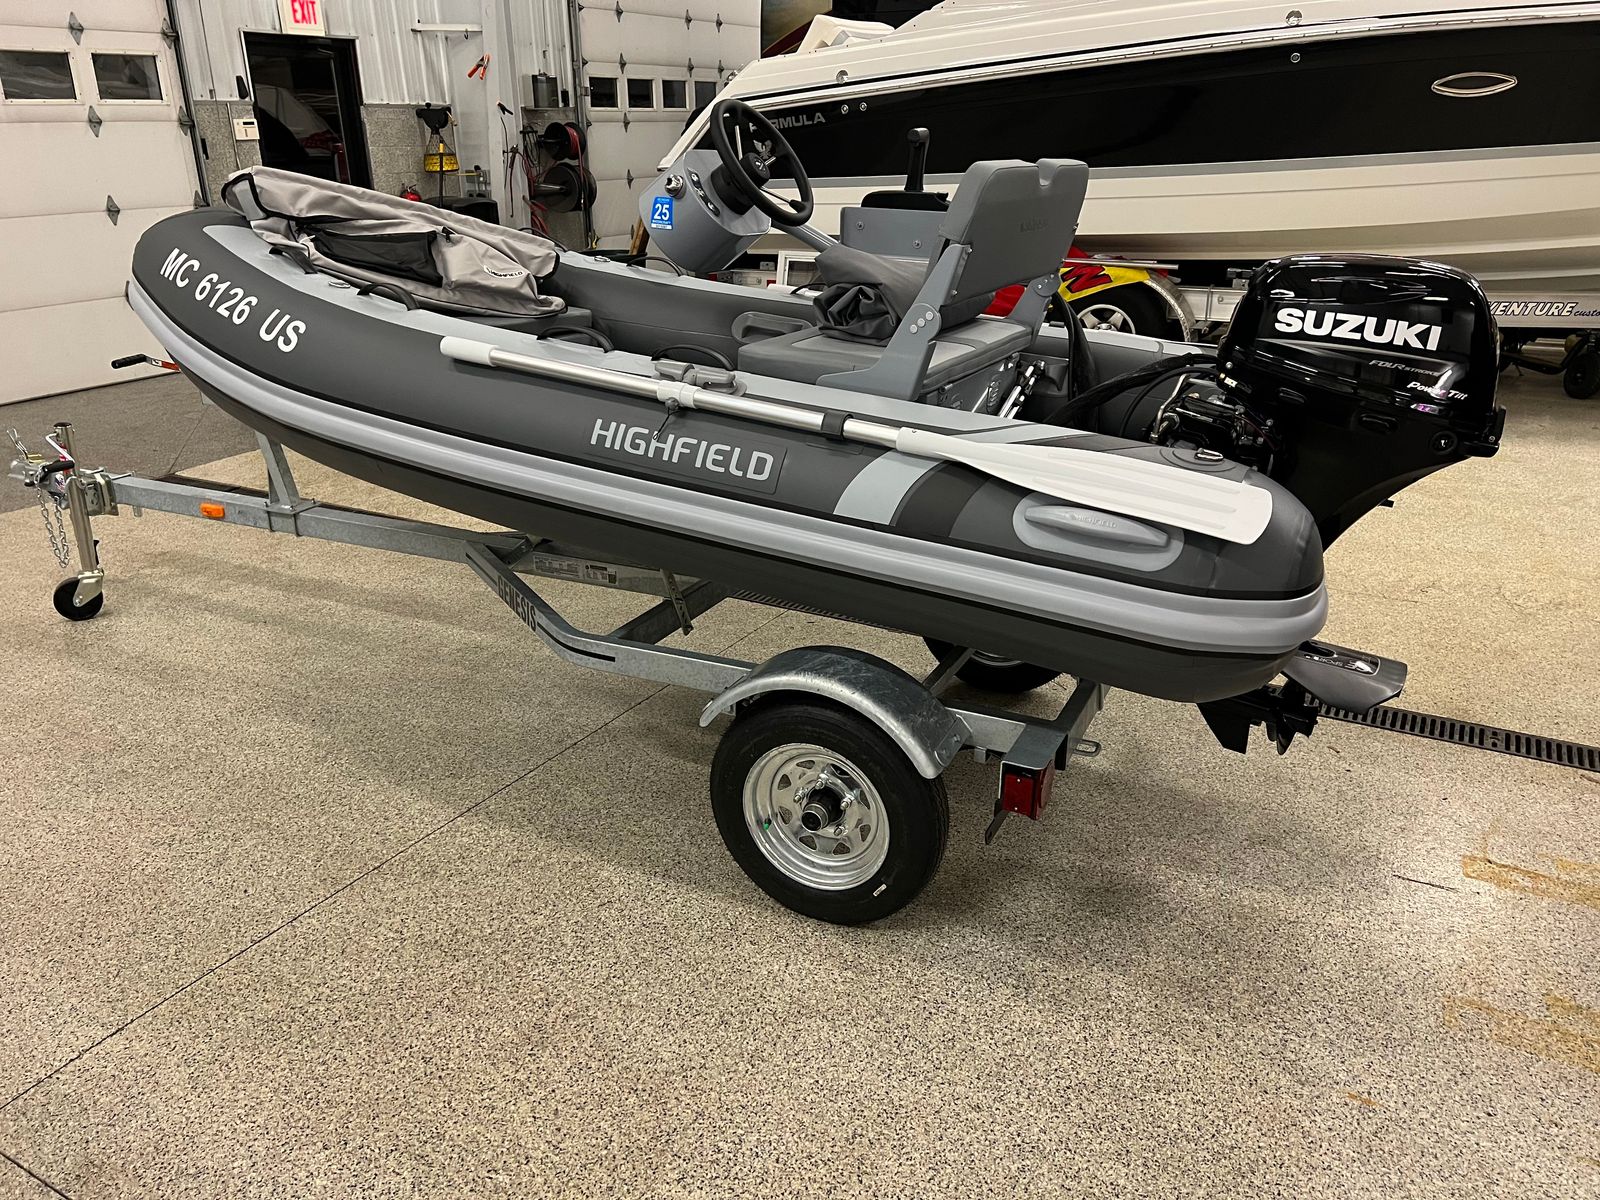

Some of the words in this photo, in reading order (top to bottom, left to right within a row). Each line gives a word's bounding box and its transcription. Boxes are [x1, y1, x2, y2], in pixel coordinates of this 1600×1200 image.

[290, 0, 317, 24] EXIT
[748, 112, 826, 134] FRMULA
[653, 203, 670, 221] 25
[160, 247, 201, 288] MC
[194, 273, 259, 325] 6126
[259, 308, 307, 353] US
[1274, 307, 1443, 351] SUZUKI
[1447, 389, 1469, 401] Tilt
[590, 418, 775, 481] HIGHFIELD
[497, 574, 537, 633] GENESIS
